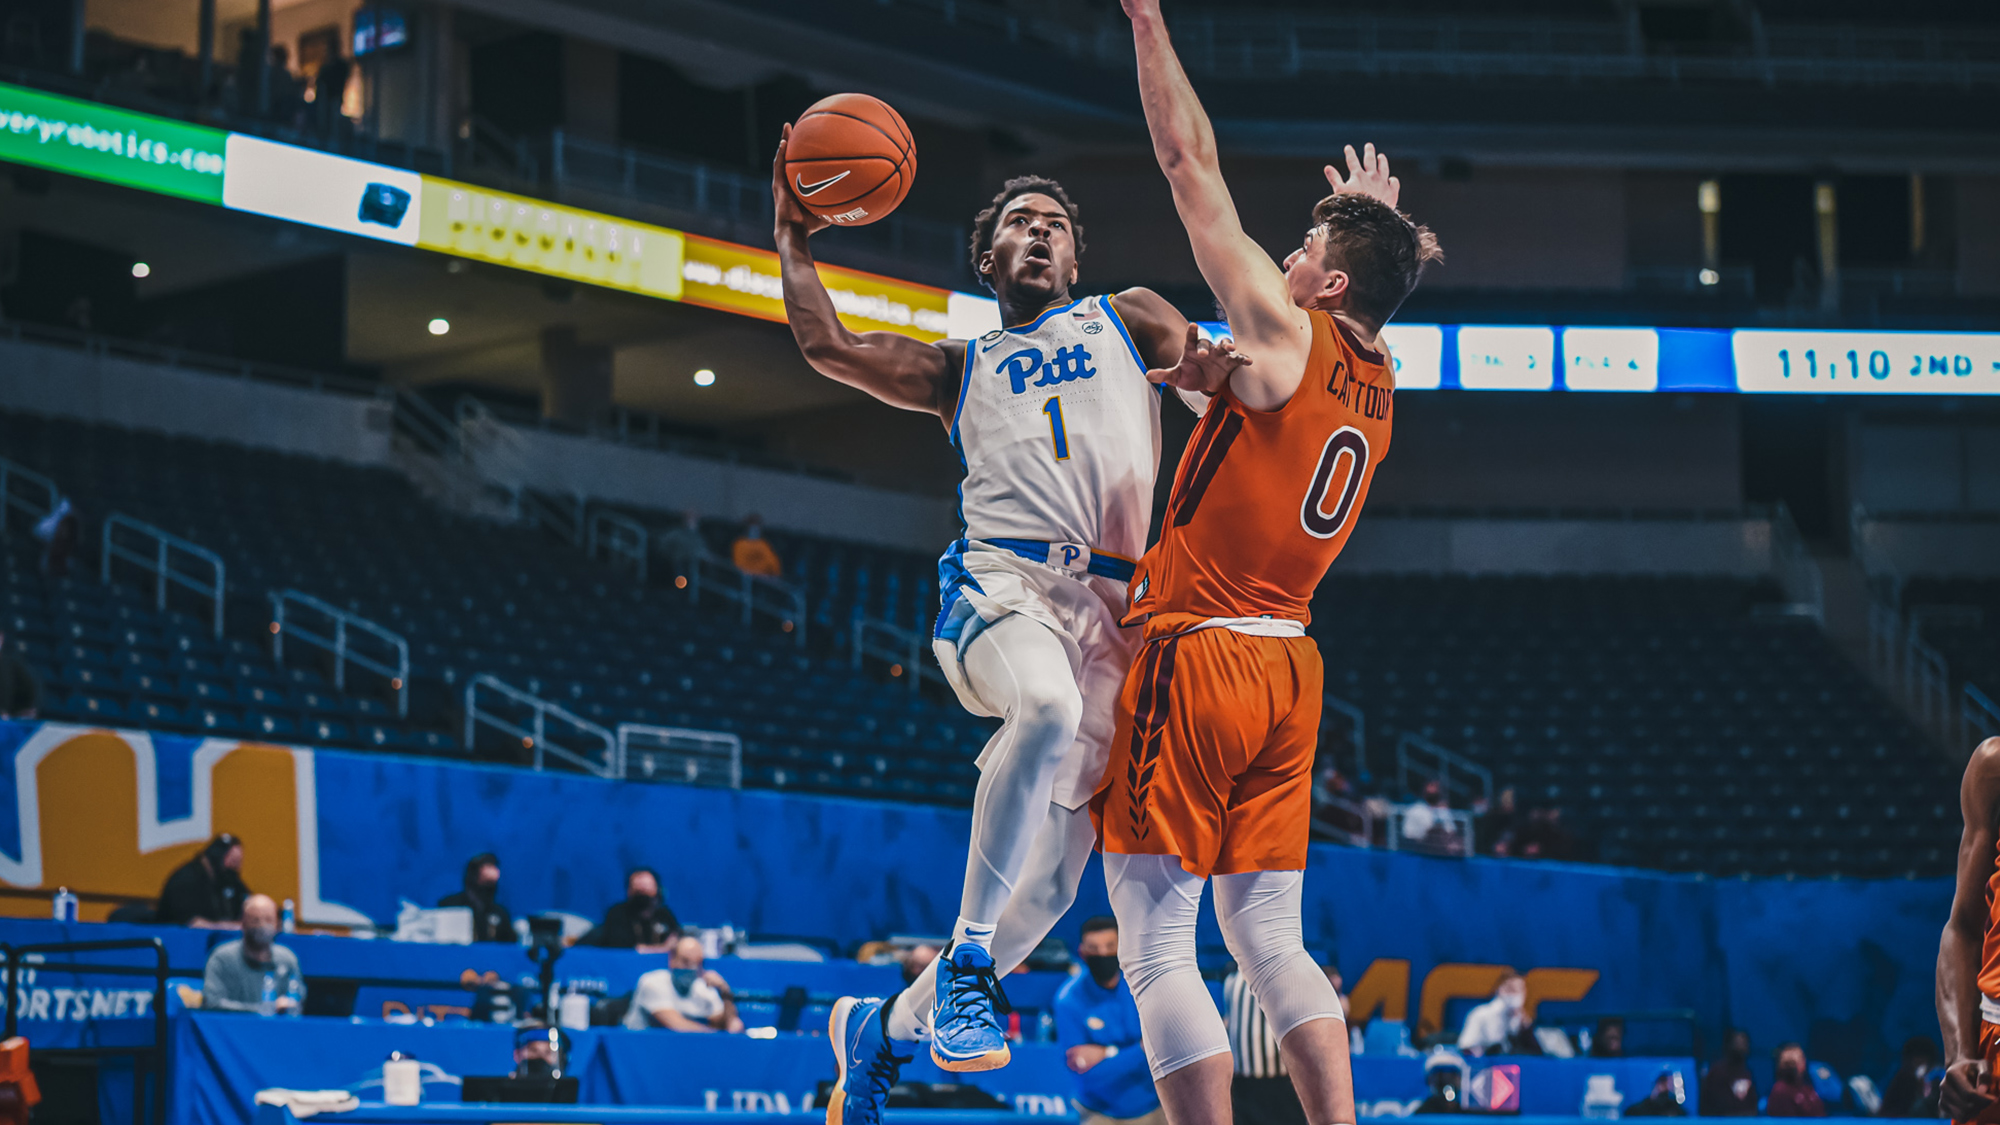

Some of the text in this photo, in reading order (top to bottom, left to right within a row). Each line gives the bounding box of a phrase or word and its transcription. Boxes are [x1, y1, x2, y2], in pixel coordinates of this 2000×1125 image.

[996, 343, 1097, 394] Pitt
[1042, 395, 1070, 461] 1
[1300, 425, 1369, 539] 0
[1060, 544, 1080, 566] P
[0, 987, 153, 1021] ORTSNET
